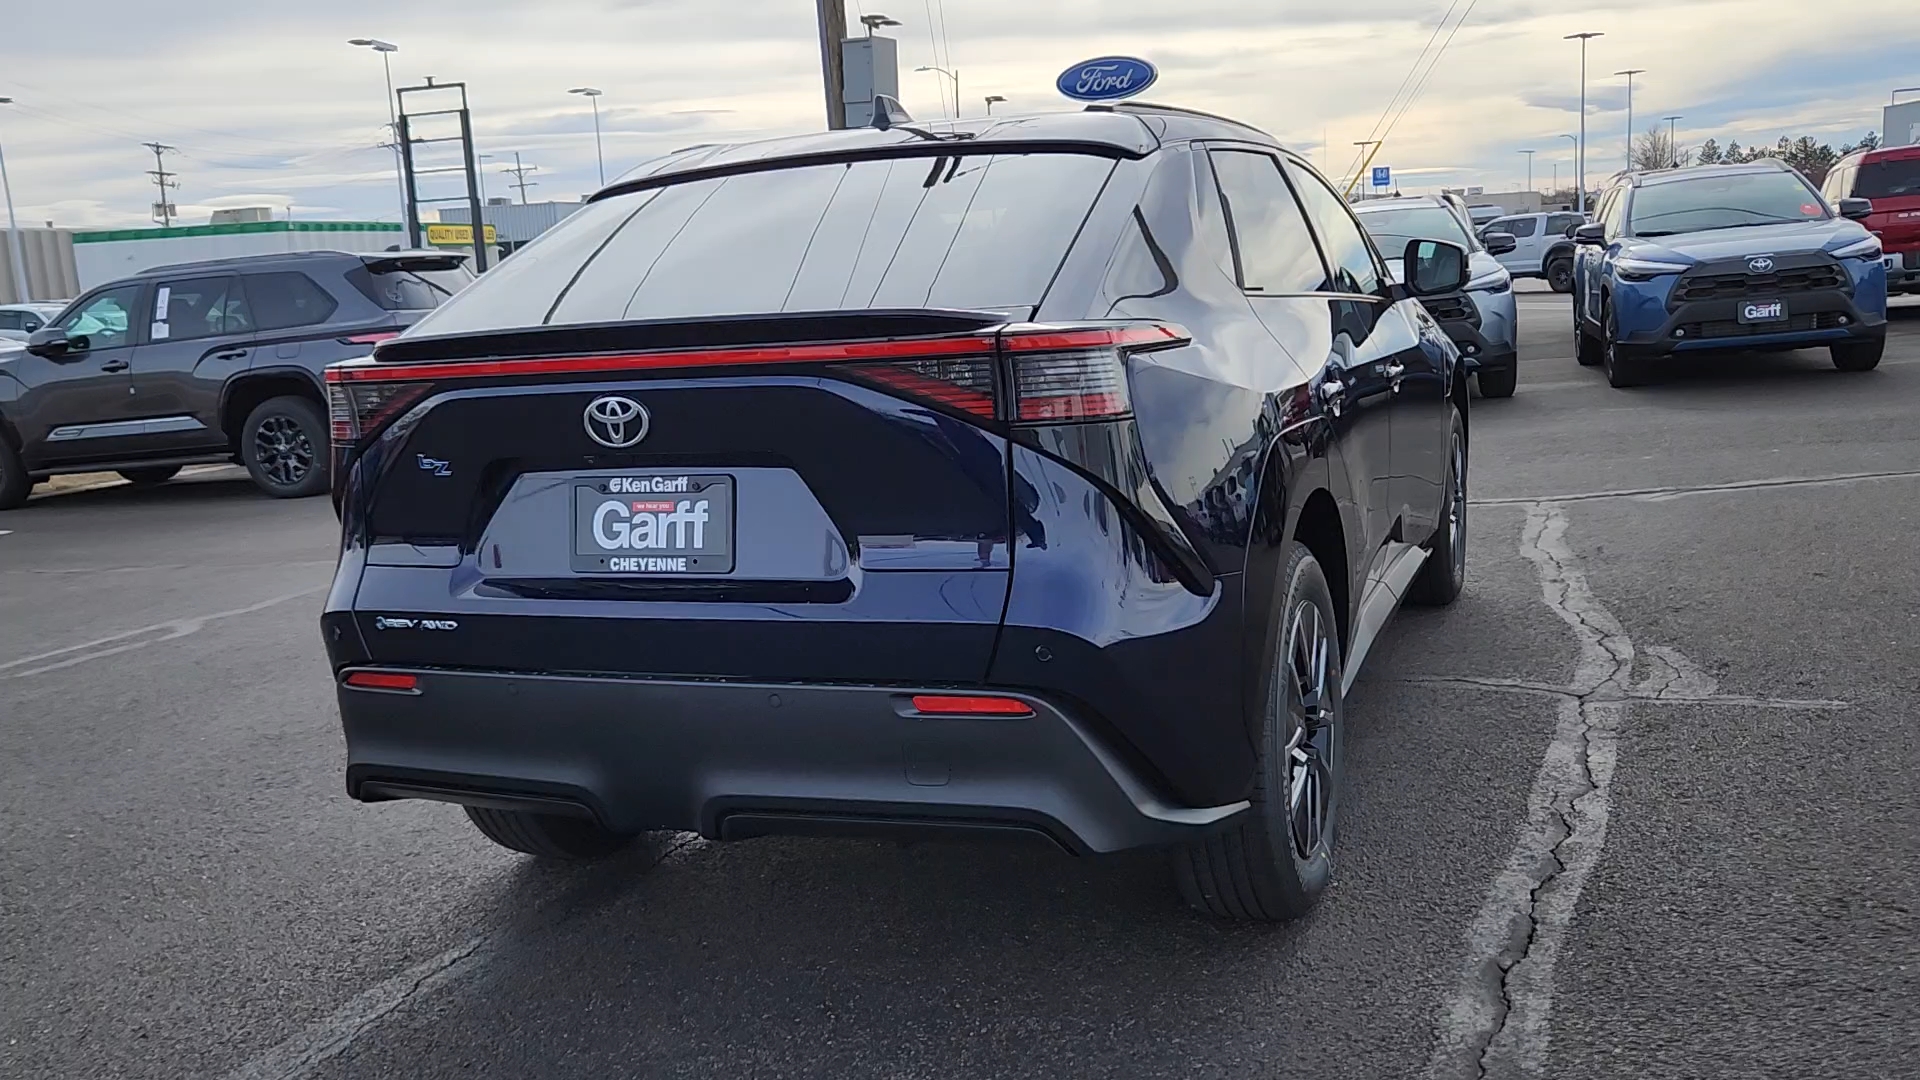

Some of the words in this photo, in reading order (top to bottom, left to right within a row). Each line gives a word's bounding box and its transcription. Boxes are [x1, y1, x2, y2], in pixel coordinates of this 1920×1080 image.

[1076, 65, 1133, 93] Ford
[430, 229, 453, 240] QUALITY
[1744, 303, 1781, 319] Garff
[622, 478, 650, 492] Ken
[651, 476, 688, 492] Garff
[659, 503, 670, 511] you
[593, 500, 709, 550] Garff
[610, 557, 687, 571] CHEYENNE
[420, 620, 458, 630] AWD
